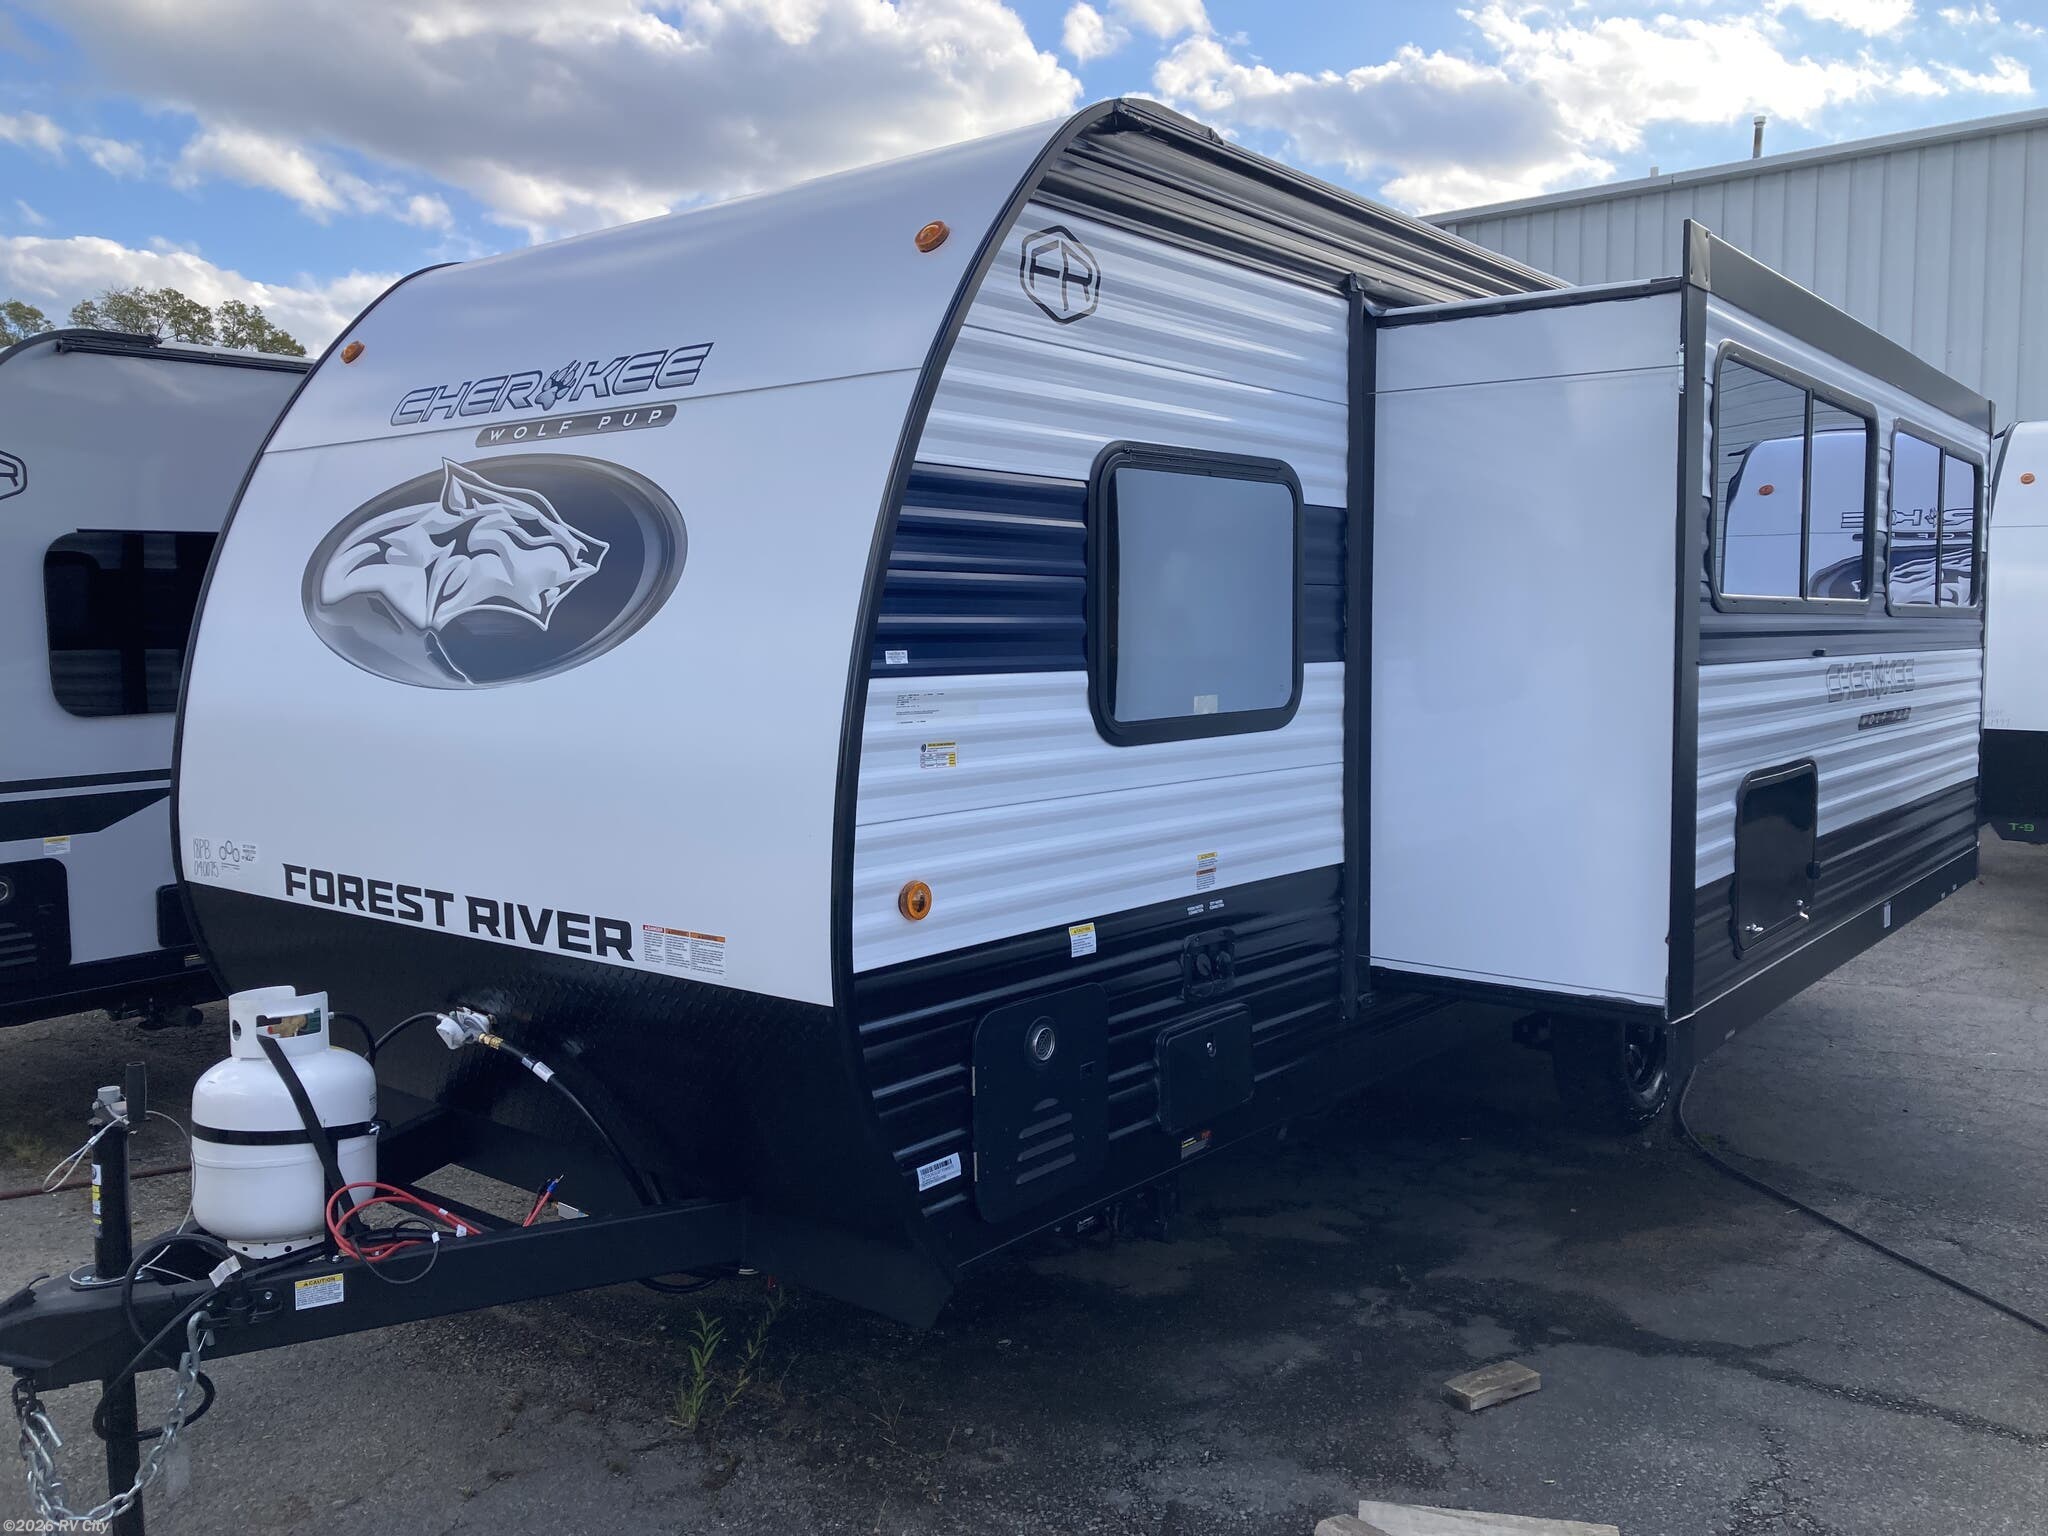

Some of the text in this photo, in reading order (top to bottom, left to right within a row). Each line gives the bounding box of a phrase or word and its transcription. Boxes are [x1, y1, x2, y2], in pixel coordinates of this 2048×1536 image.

[390, 342, 714, 426] CHEROKEE
[489, 409, 662, 441] WOLF PUP
[282, 863, 454, 927] FOREST
[464, 895, 634, 962] RIVER
